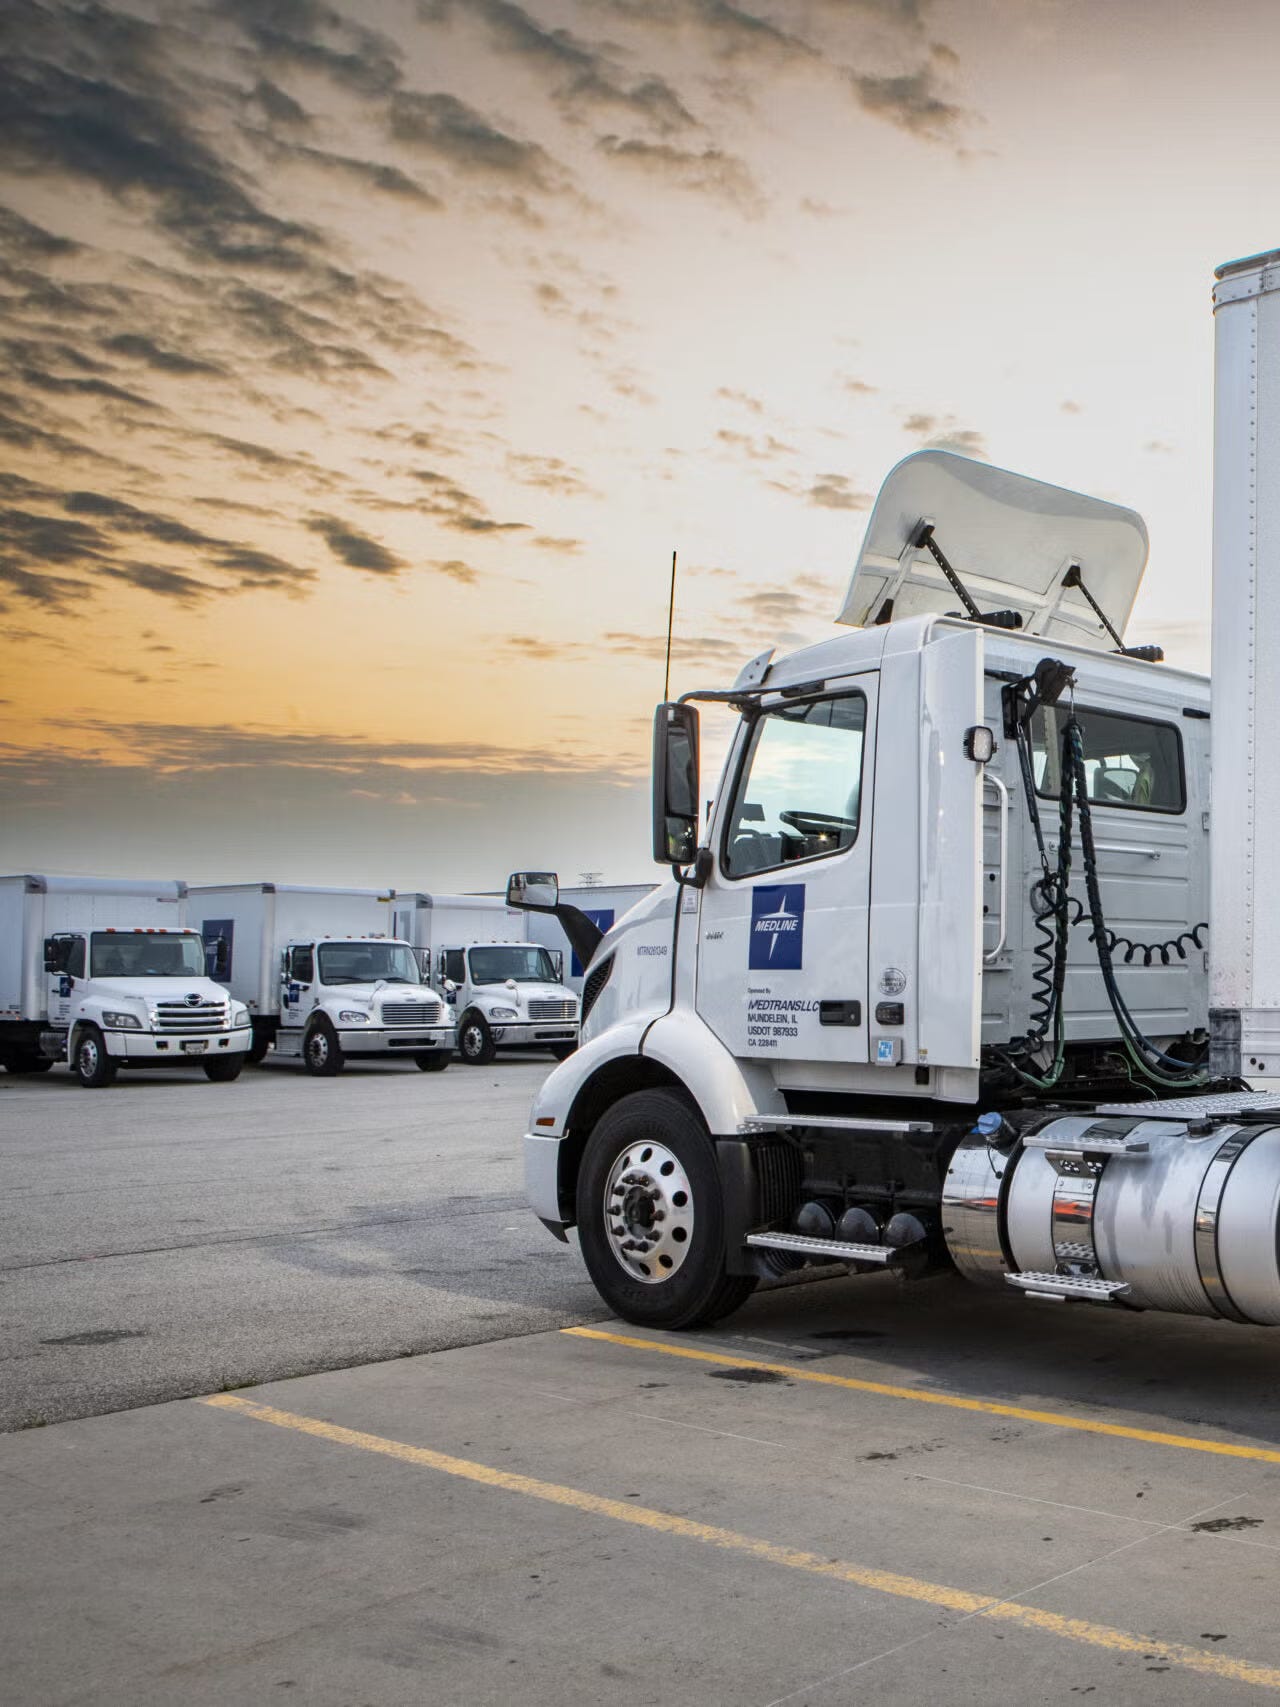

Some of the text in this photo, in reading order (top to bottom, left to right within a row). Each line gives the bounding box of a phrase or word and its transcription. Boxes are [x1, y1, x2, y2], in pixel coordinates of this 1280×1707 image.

[755, 920, 798, 931] MEDLINE
[748, 1013, 798, 1024] MUNDELEIN, IL
[748, 1026, 798, 1037] USDOT 987933
